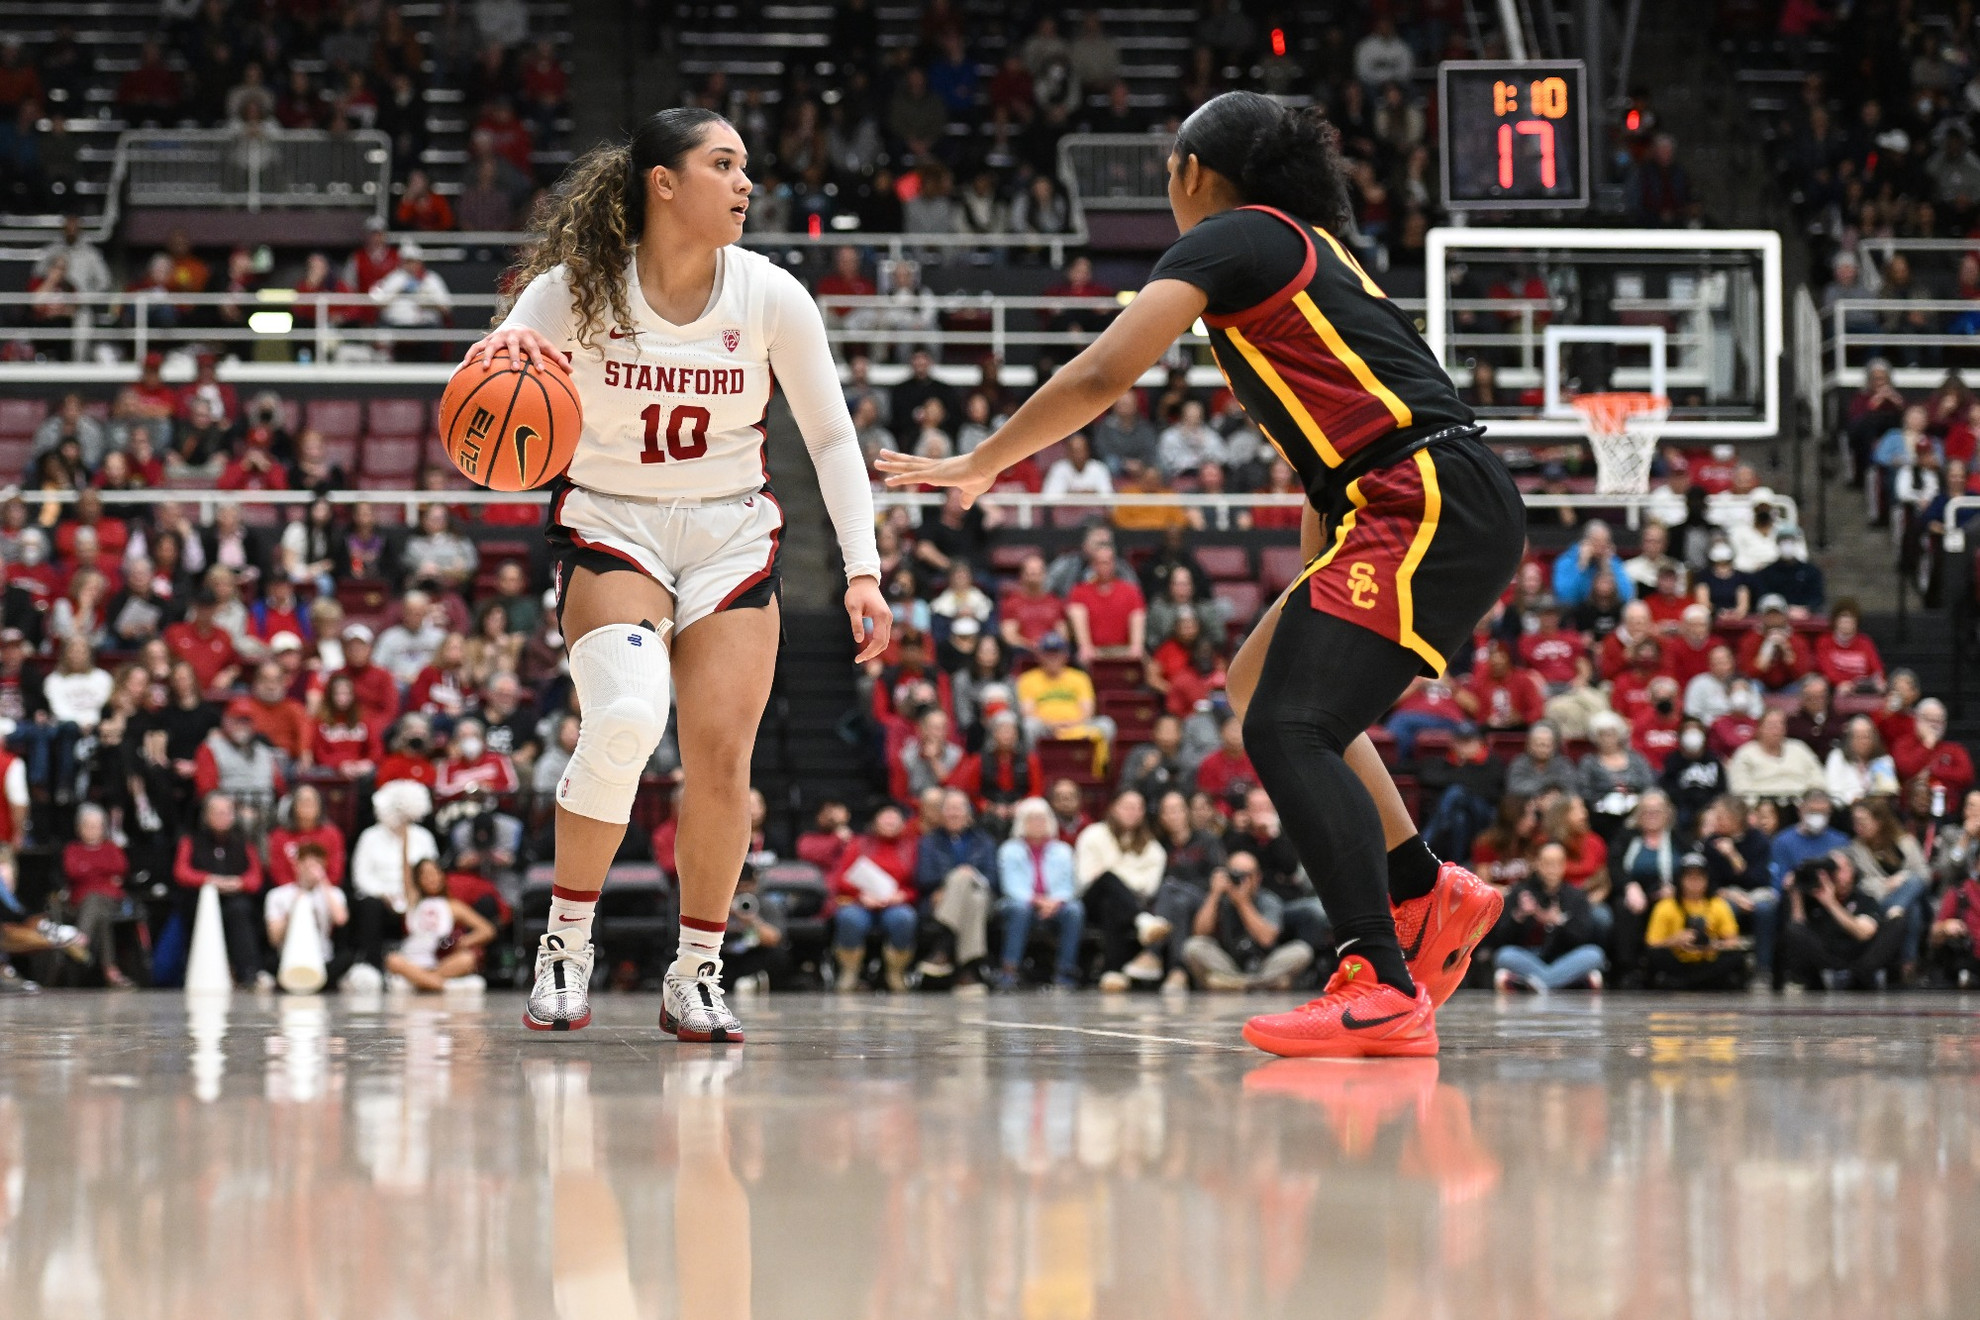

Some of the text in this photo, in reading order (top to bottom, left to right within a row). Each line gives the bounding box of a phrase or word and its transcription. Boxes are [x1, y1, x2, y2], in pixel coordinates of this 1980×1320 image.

[1493, 77, 1568, 119] 1:10
[1498, 120, 1556, 189] 17
[604, 360, 744, 395] STANFORD
[460, 406, 495, 475] ELITE
[640, 403, 711, 464] 10
[1346, 561, 1379, 609] SC
